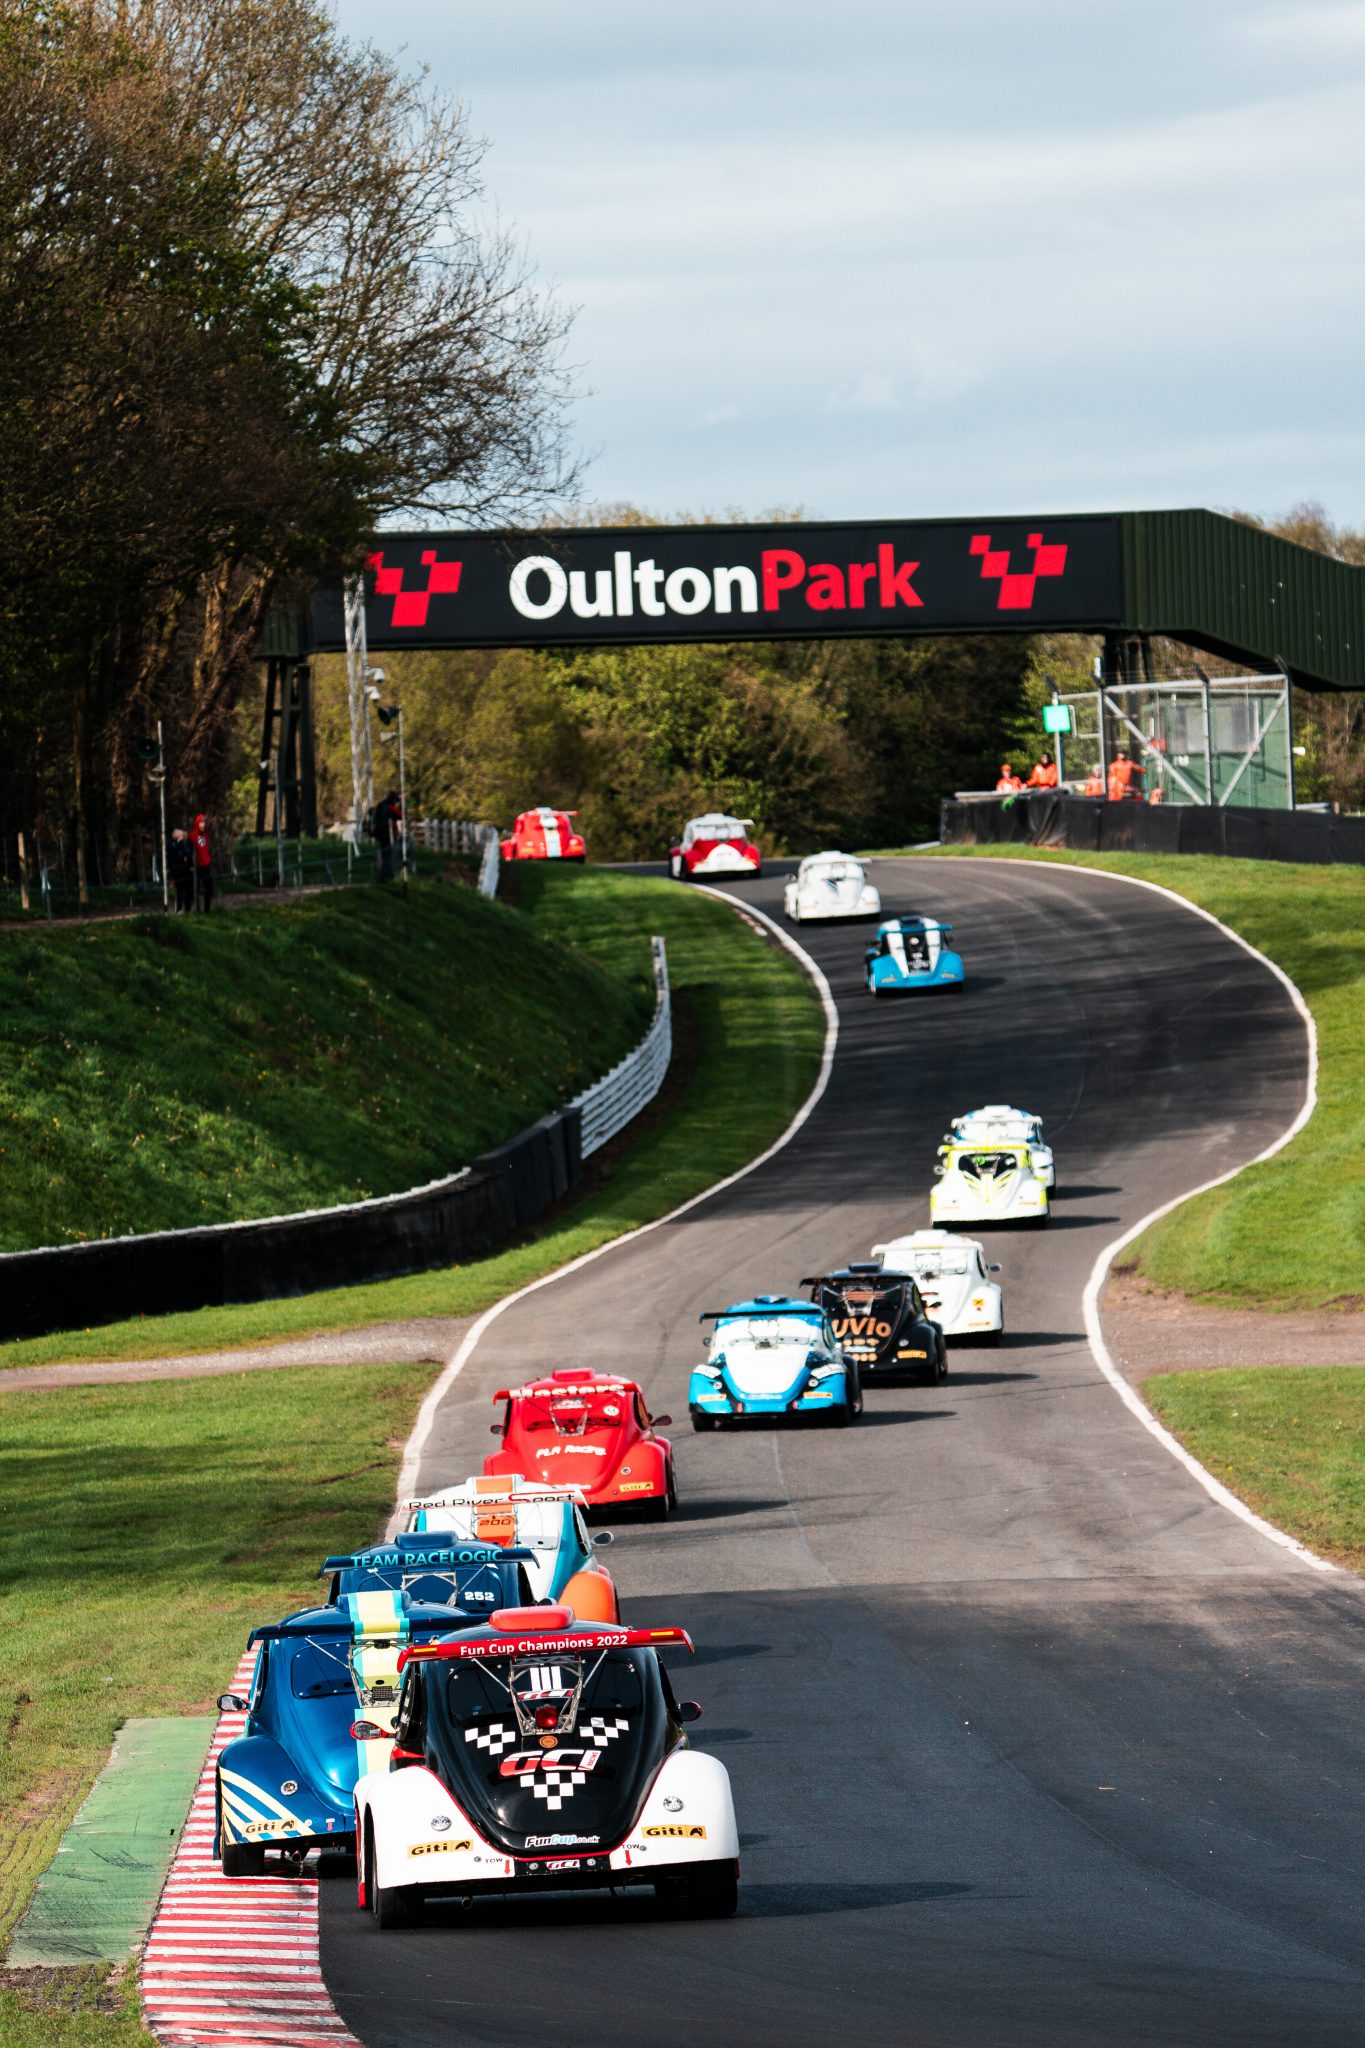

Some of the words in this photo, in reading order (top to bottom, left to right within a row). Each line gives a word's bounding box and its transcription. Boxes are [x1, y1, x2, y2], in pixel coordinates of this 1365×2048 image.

[409, 1501, 446, 1510] Red
[452, 1498, 503, 1506] River
[351, 1554, 399, 1567] TEAM
[405, 1549, 503, 1565] RACELOGIC
[464, 1591, 495, 1601] 252
[460, 1646, 485, 1656] Fun
[489, 1643, 515, 1654] Cup
[518, 1637, 593, 1652] Champions
[596, 1635, 628, 1647] 2022
[499, 1749, 602, 1777] GCI
[245, 1822, 276, 1834] Giti
[646, 1826, 683, 1836] Giti
[411, 1843, 448, 1856] Giti
